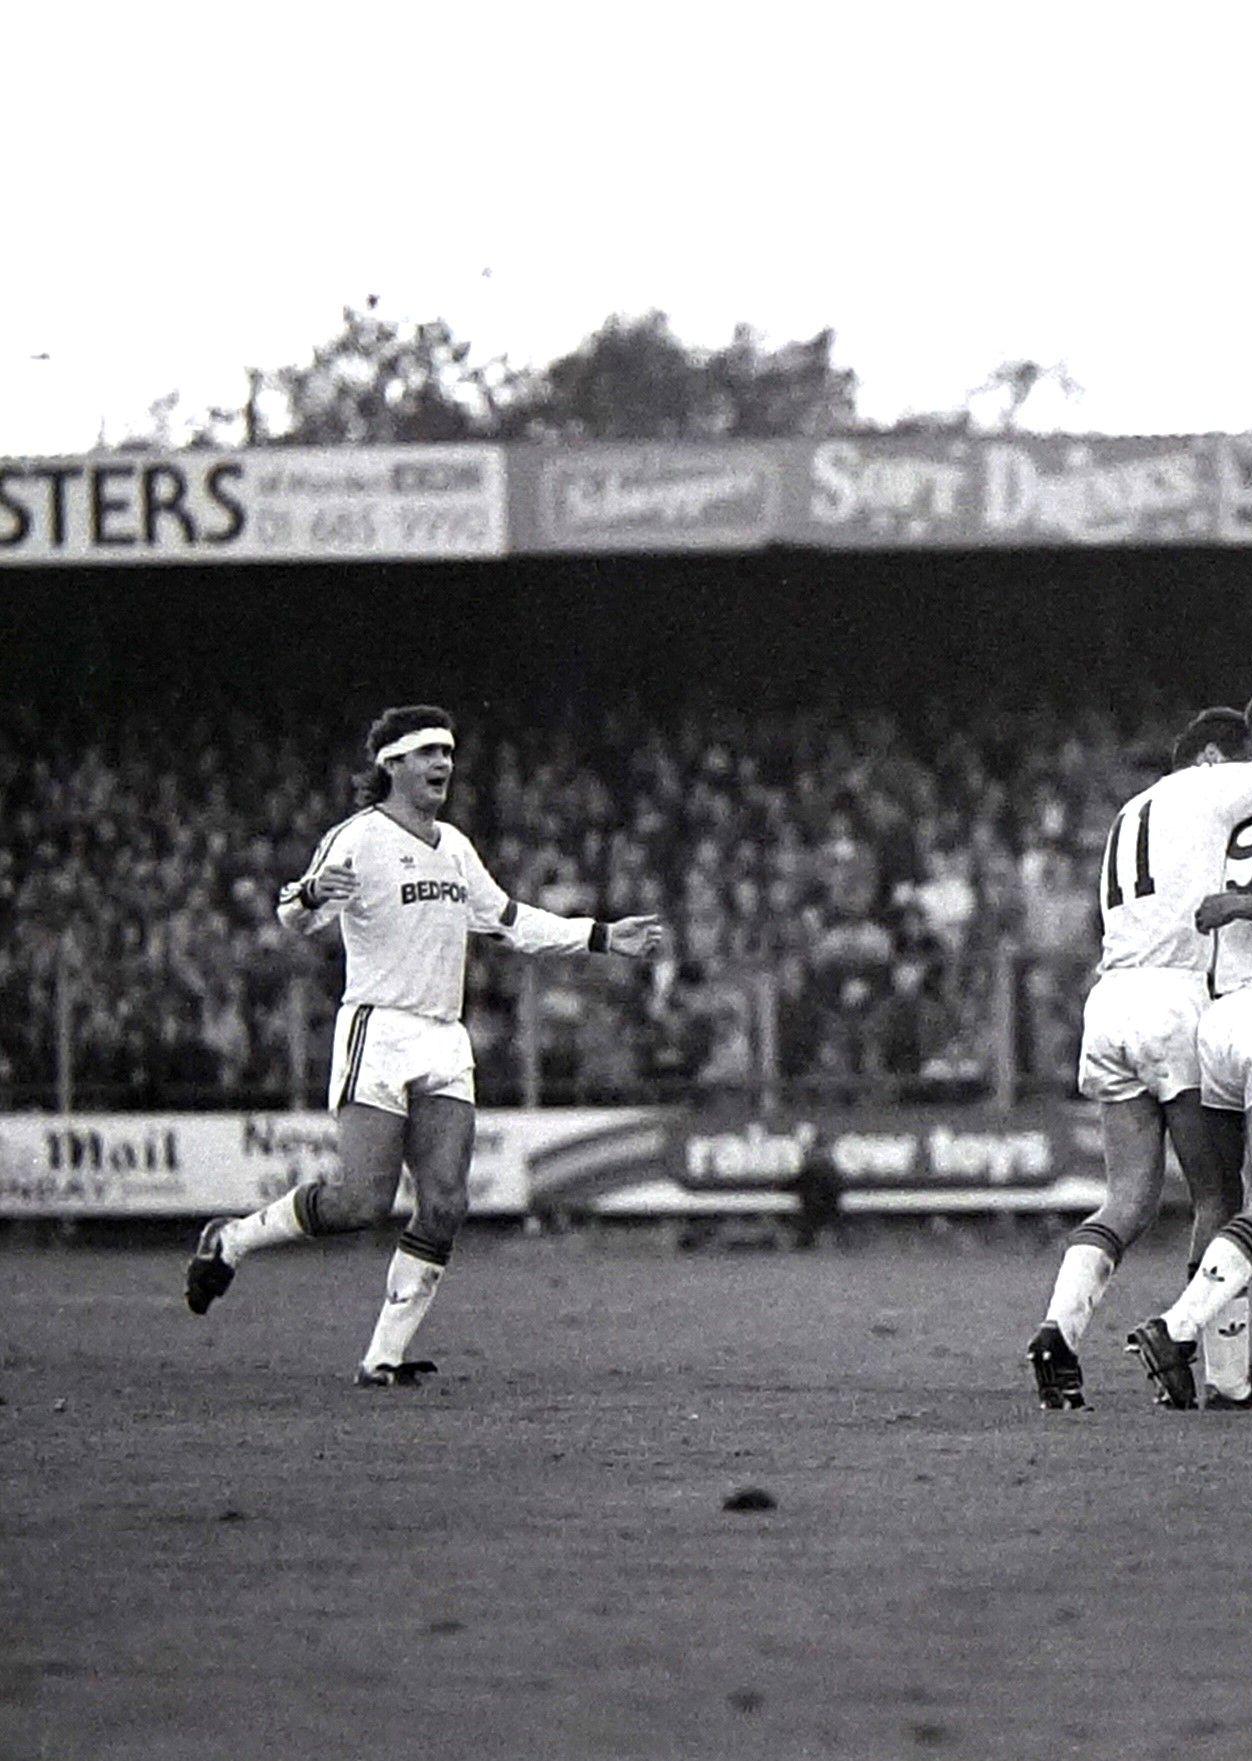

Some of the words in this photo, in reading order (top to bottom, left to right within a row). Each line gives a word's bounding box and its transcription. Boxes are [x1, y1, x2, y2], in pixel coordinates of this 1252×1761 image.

[0, 462, 246, 546] STERS
[1107, 799, 1156, 910] 11
[46, 1128, 180, 1171] Mail
[685, 1122, 917, 1178] rainow
[928, 1124, 1052, 1183] toys
